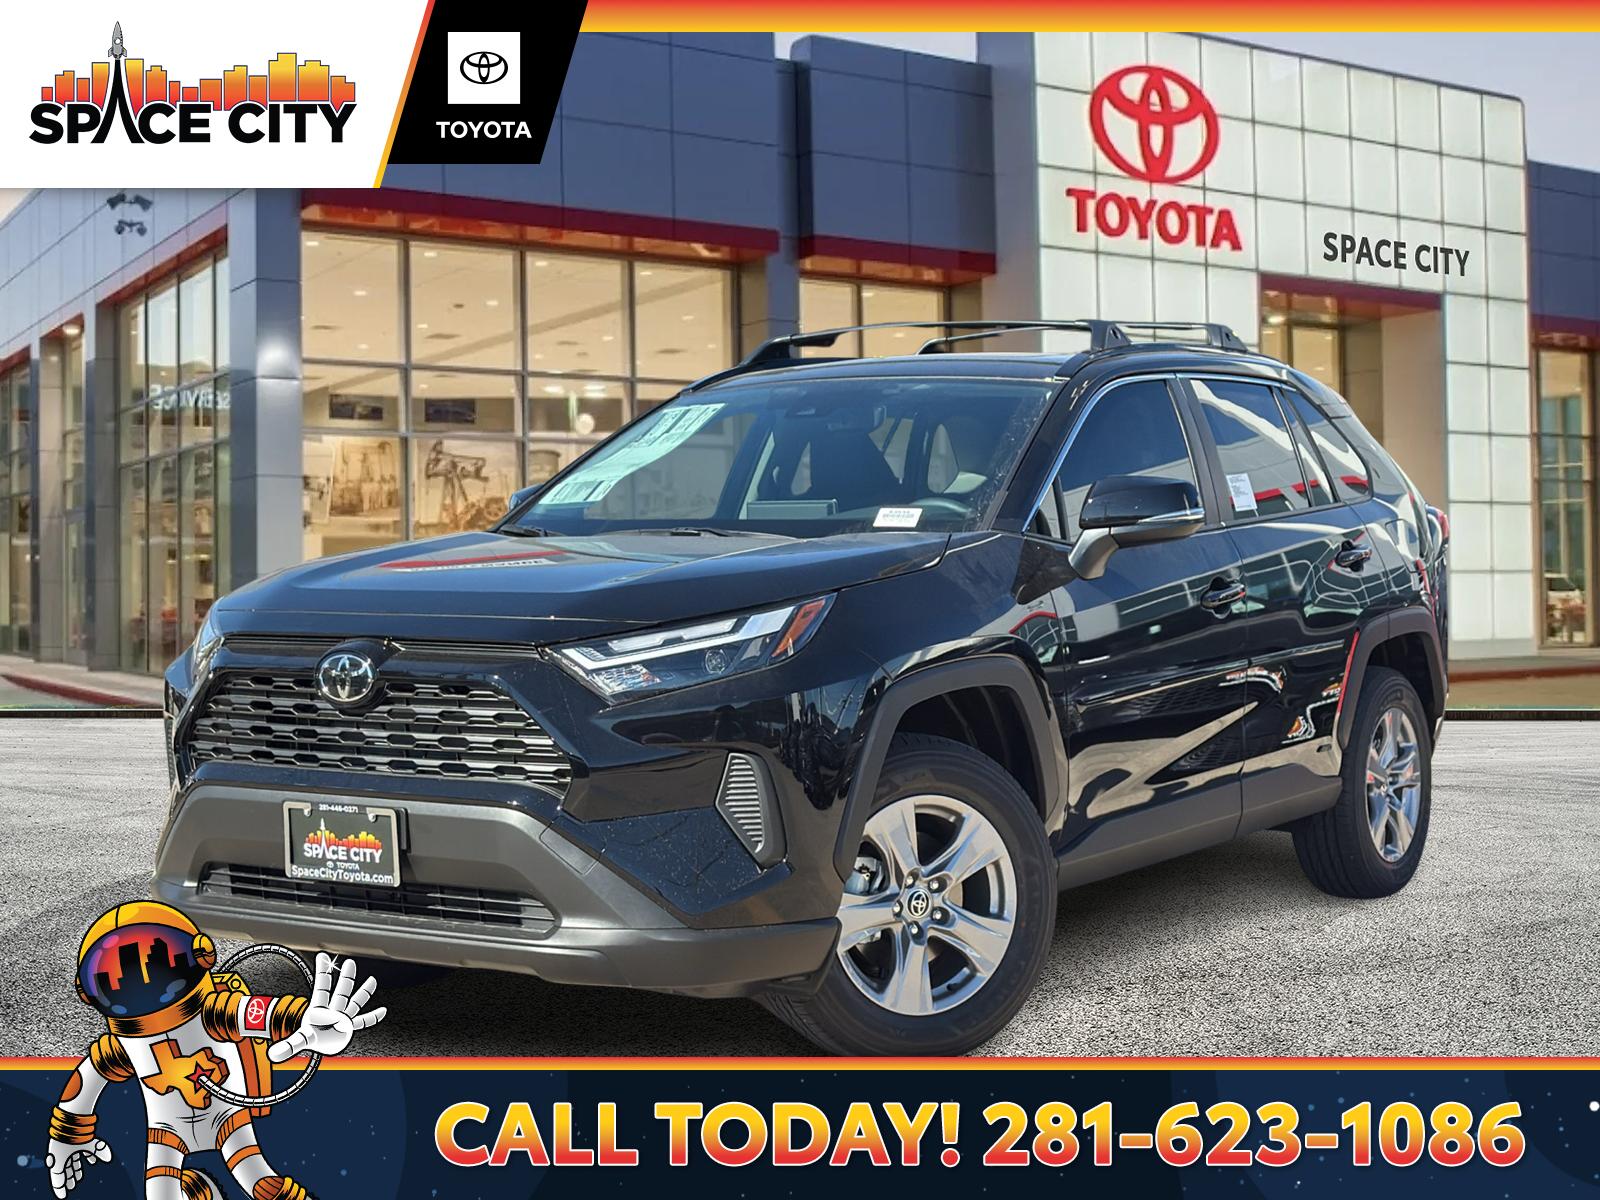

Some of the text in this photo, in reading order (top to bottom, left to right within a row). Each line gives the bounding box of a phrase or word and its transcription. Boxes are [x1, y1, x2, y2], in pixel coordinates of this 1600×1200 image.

[1066, 187, 1243, 251] TOYOTA
[1323, 231, 1471, 277] SPACE CITY
[304, 841, 383, 863] SPACE CITY
[291, 864, 394, 884] SpaceCityToyota.com
[336, 861, 360, 871] TOYOTA
